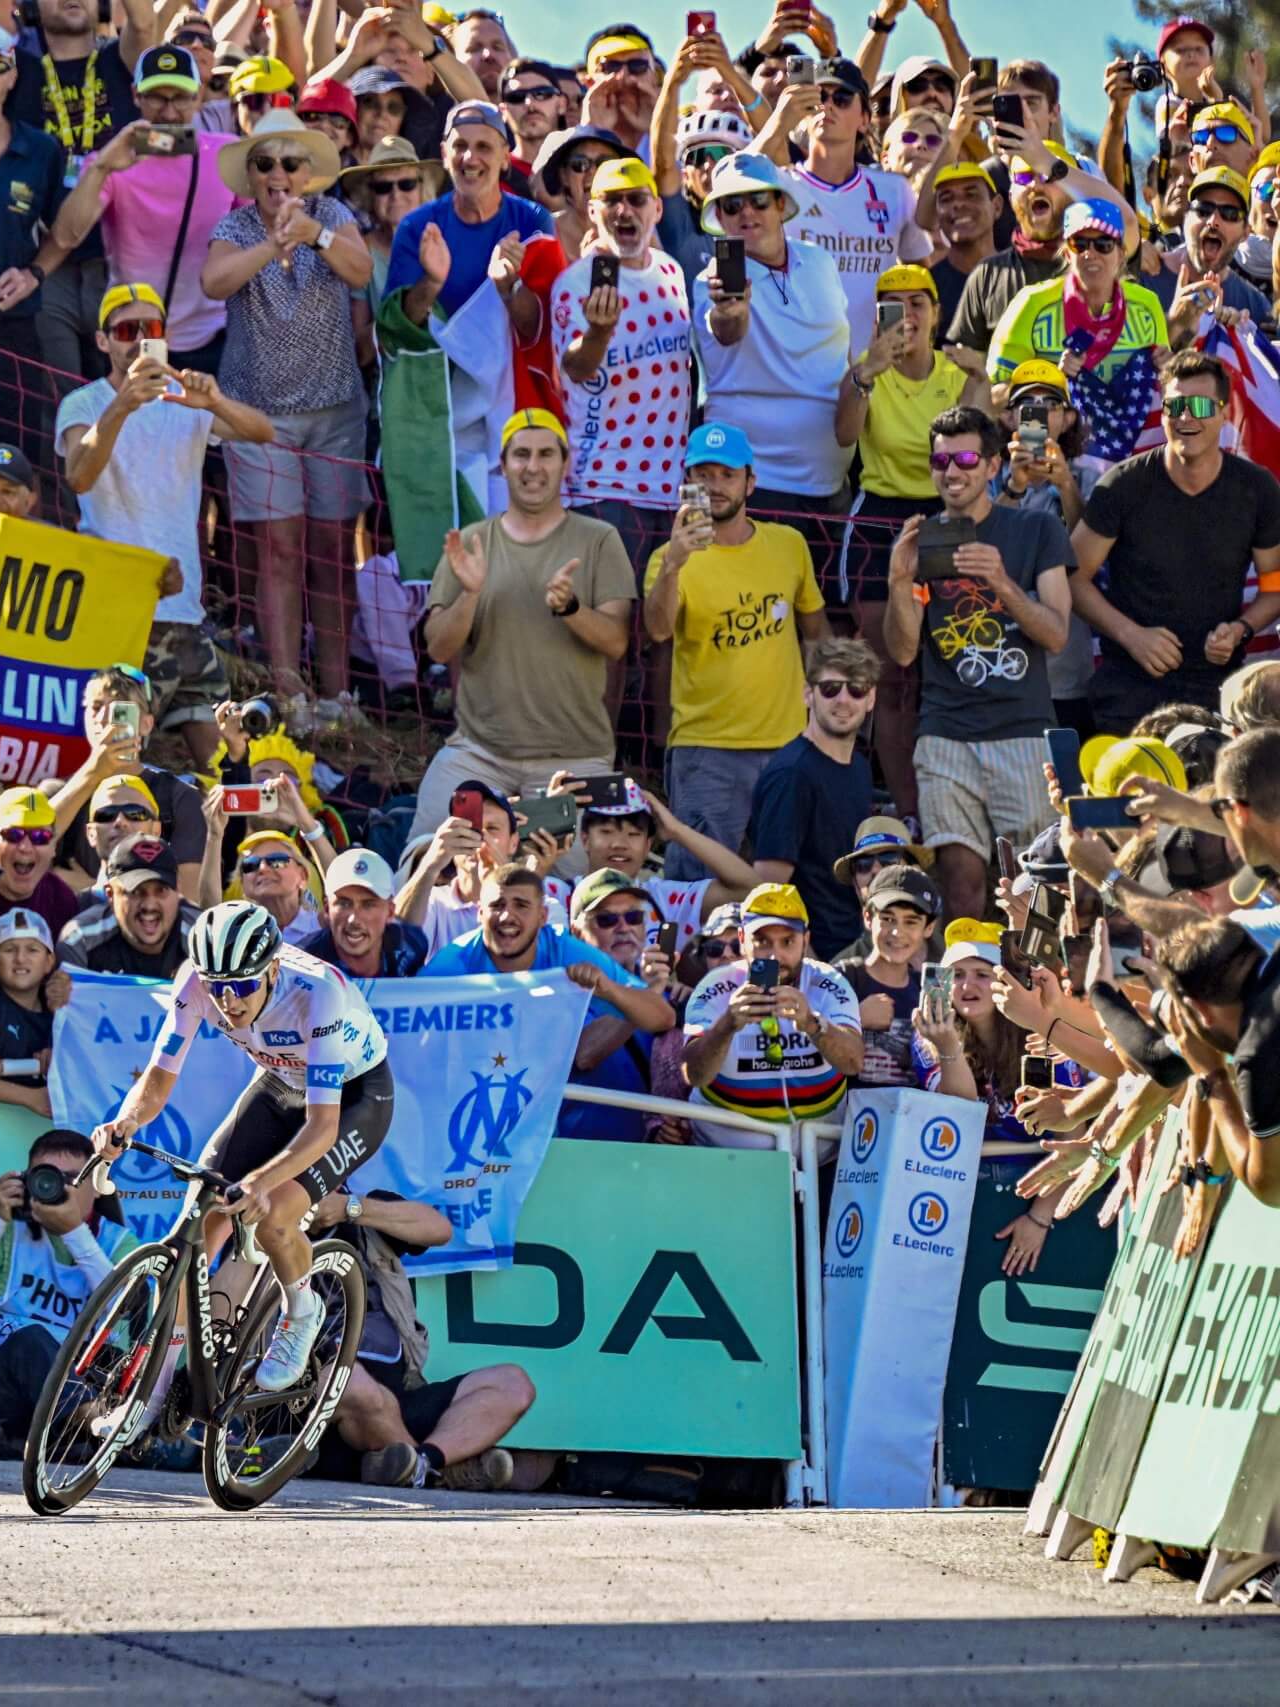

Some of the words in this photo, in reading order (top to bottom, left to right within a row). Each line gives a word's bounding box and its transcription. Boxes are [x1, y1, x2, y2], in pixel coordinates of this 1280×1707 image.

[799, 229, 894, 253] Emirates
[838, 255, 882, 273] BETTER
[697, 979, 738, 1004] BORA
[372, 1002, 514, 1034] REMIERS
[269, 1032, 298, 1045] Krys
[313, 1067, 343, 1087] Kry
[324, 1129, 368, 1176] UAE
[837, 1168, 880, 1185] E.Leclerc
[904, 1159, 967, 1182] E.Leclerc
[892, 1234, 955, 1258] E.Leclerc
[822, 1262, 865, 1280] E.Leclerc
[21, 1273, 90, 1319] PHOT
[195, 1251, 217, 1359] COLNAGO
